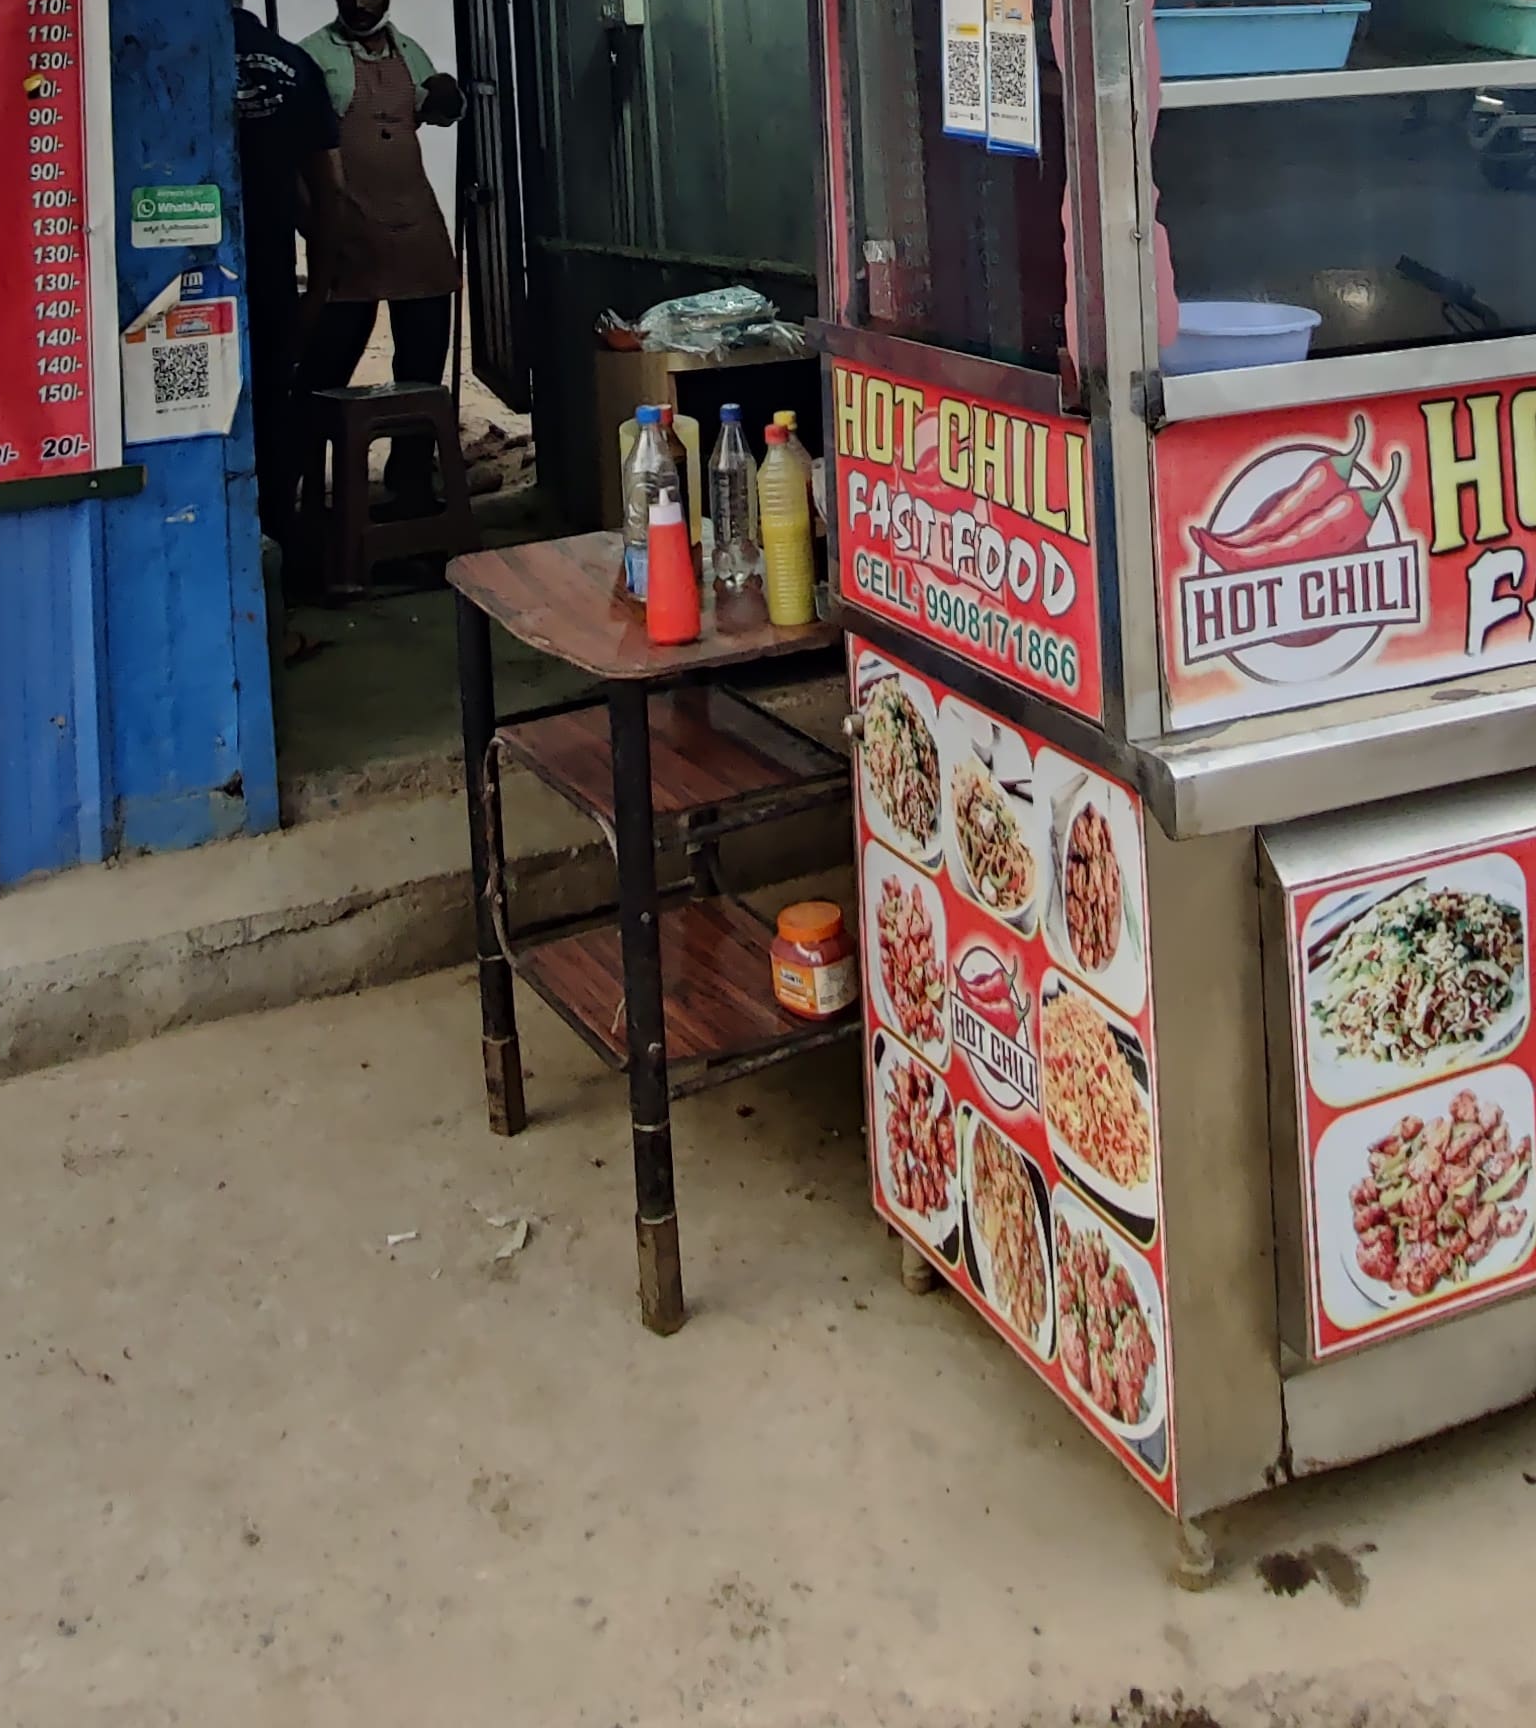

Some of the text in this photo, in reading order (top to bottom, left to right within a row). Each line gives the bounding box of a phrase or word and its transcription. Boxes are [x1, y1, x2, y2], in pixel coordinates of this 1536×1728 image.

[29, 51, 74, 70] 130/-
[29, 107, 64, 126] 90/-
[30, 162, 65, 181] 90/-
[32, 189, 77, 209] 100/-
[33, 217, 79, 237] 130/-
[34, 272, 81, 292] 130/-
[35, 300, 81, 320] 140/-
[37, 355, 83, 376] 140/-
[38, 383, 84, 403] 150/-
[41, 437, 90, 459] 20/-
[835, 367, 1091, 546] HOT CHILI
[847, 470, 1077, 617] FAST FOOD
[1194, 554, 1416, 648] HOT CHILI
[856, 553, 1077, 689] CELL: 9908171866
[954, 1003, 1036, 1100] HOT CHILI
